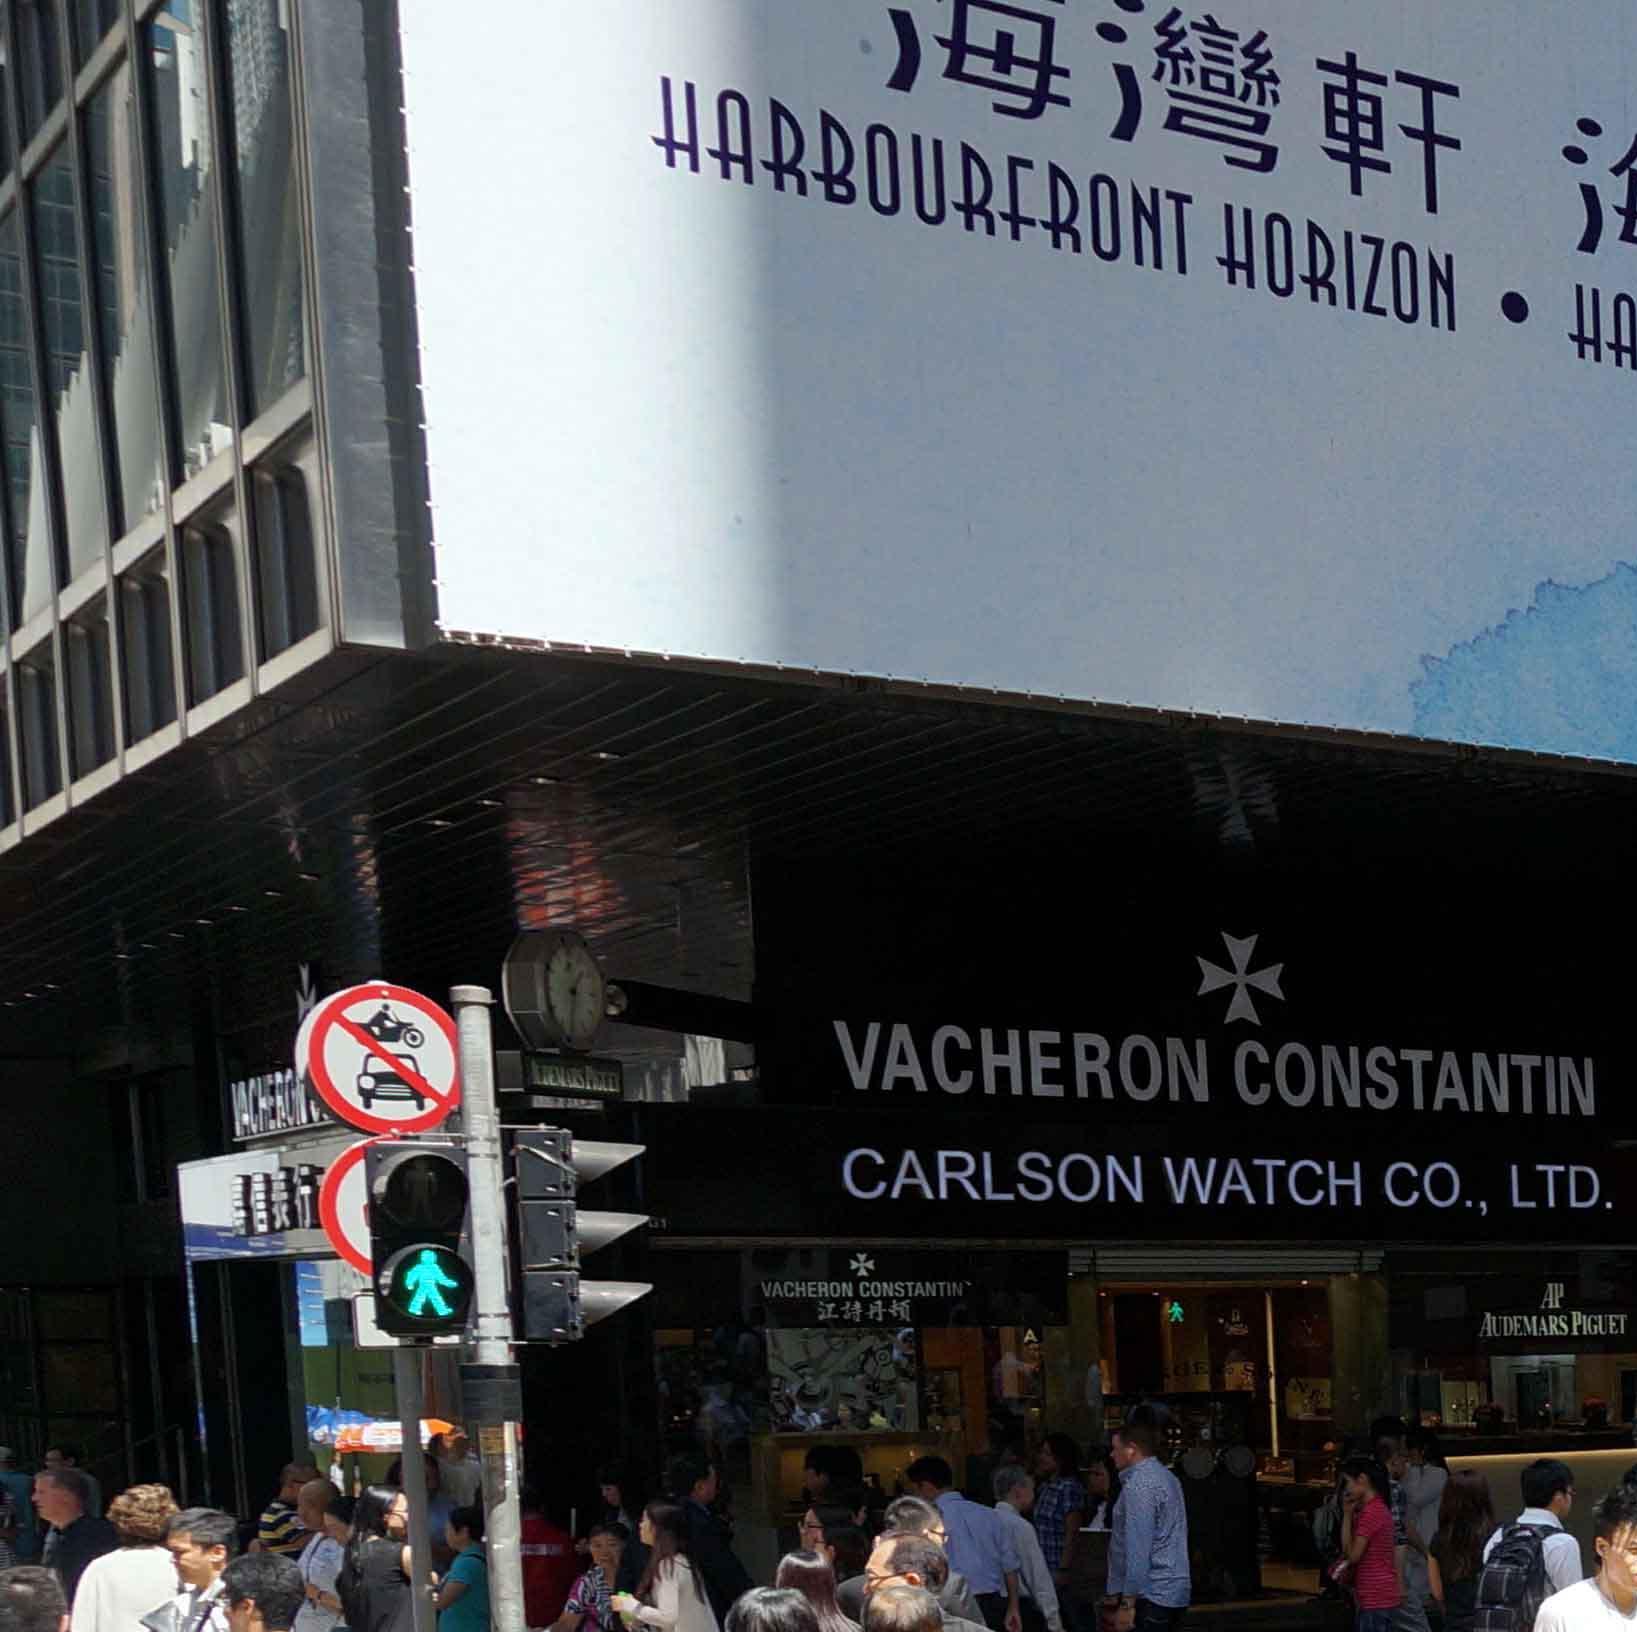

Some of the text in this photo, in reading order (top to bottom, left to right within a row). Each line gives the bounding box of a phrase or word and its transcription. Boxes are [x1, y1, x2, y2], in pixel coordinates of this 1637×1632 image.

[651, 75, 1457, 332] HARBOURFRONT HORIZON
[833, 1018, 1596, 1117] VACHERON CONSTANTIN
[841, 1147, 1614, 1216] CARLSON WATCH CO., LTD.
[761, 1280, 964, 1298] VACHERON CONSTANTIN
[816, 1299, 914, 1323] 江詩丹頓
[1479, 1311, 1629, 1338] AUDEMARS PIGUET
